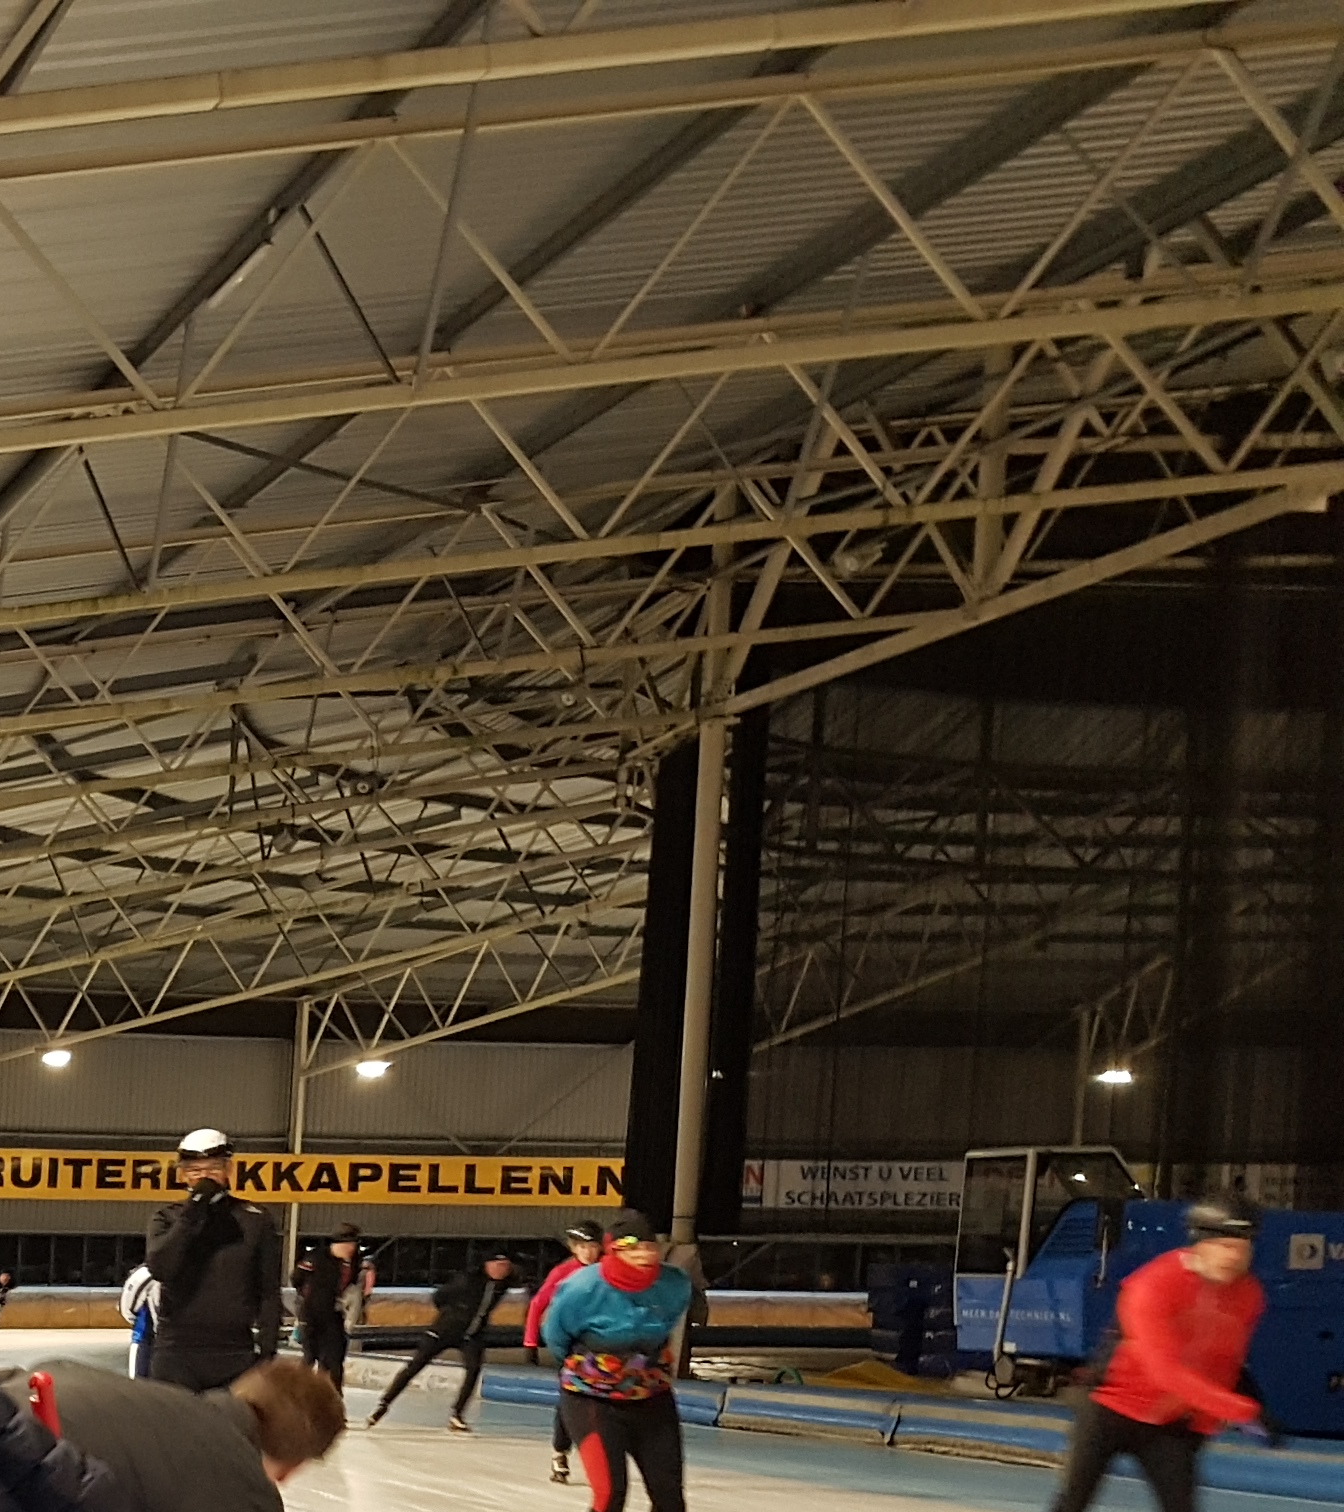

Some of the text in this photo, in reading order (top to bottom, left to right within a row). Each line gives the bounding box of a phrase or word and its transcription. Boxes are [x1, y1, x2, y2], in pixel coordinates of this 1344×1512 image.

[800, 1165, 949, 1183] WENST U VEEL
[784, 1191, 961, 1208] SCHAATSPLEZIER
